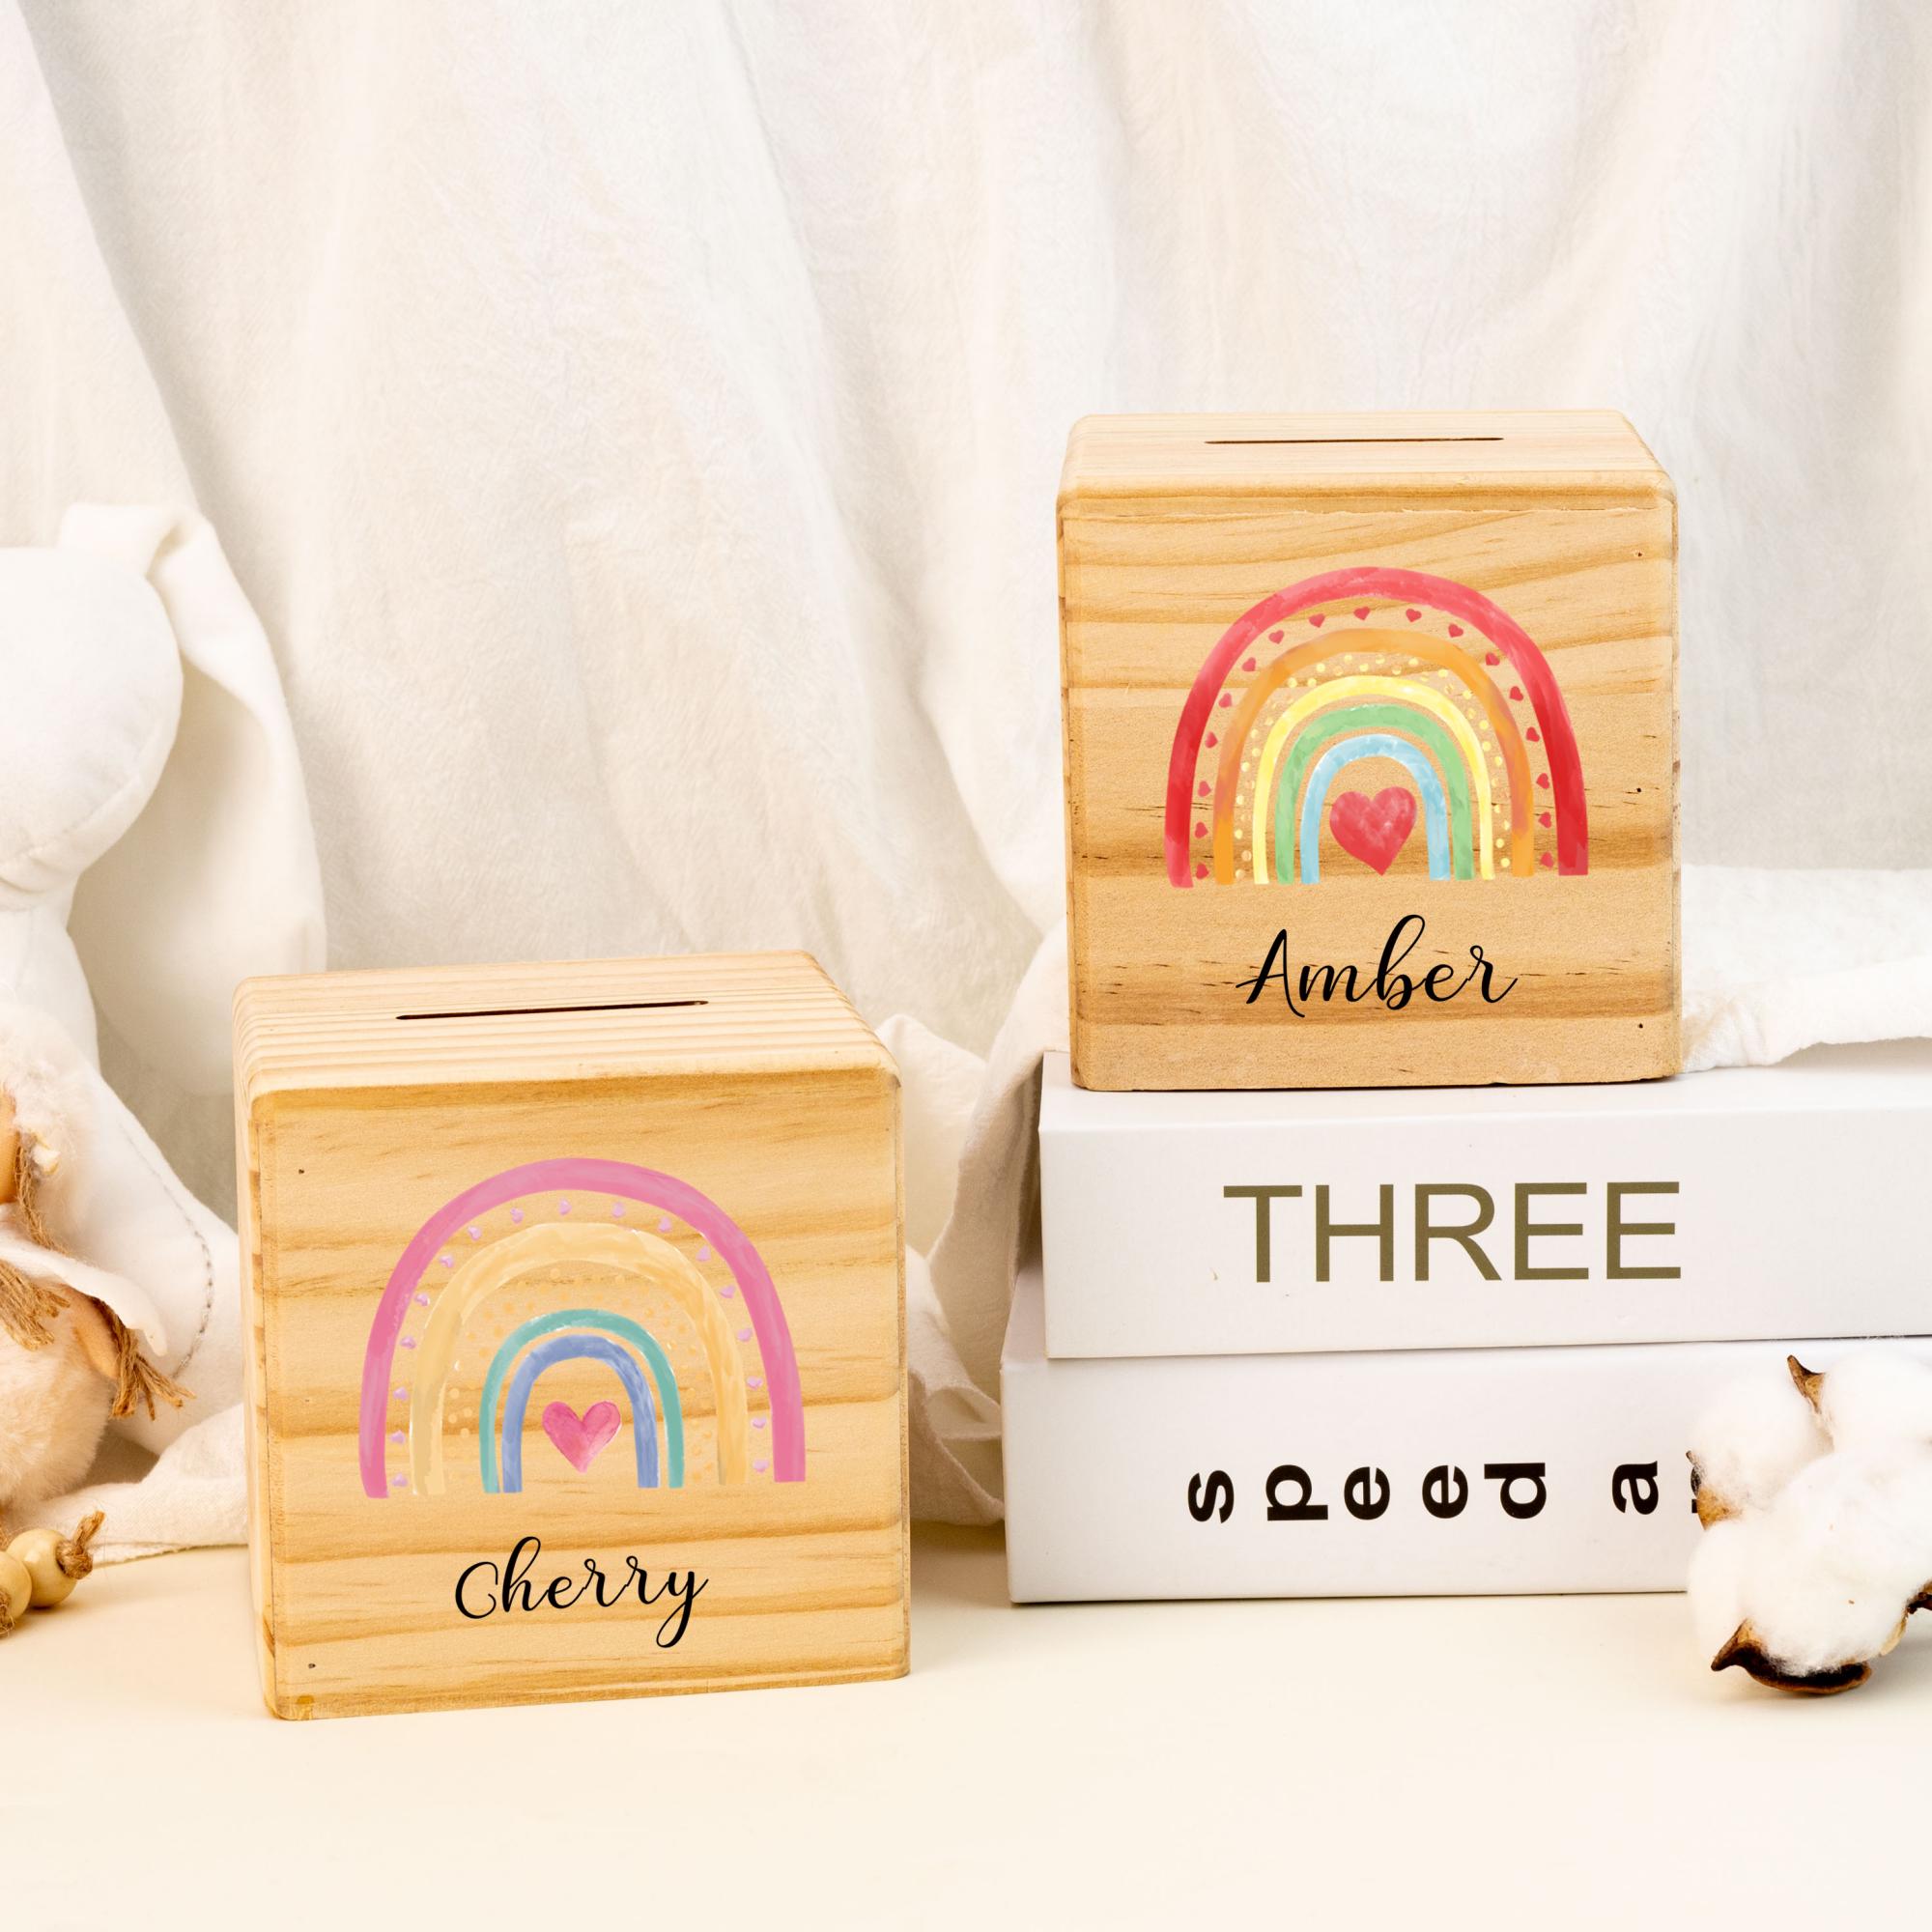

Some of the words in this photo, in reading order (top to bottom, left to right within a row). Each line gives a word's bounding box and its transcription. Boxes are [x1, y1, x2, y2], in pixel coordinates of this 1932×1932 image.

[1236, 914, 1519, 1018] Amber
[1223, 1181, 1682, 1283] THREE
[1187, 1462, 1547, 1523] speed
[455, 1536, 709, 1648] Cherry
